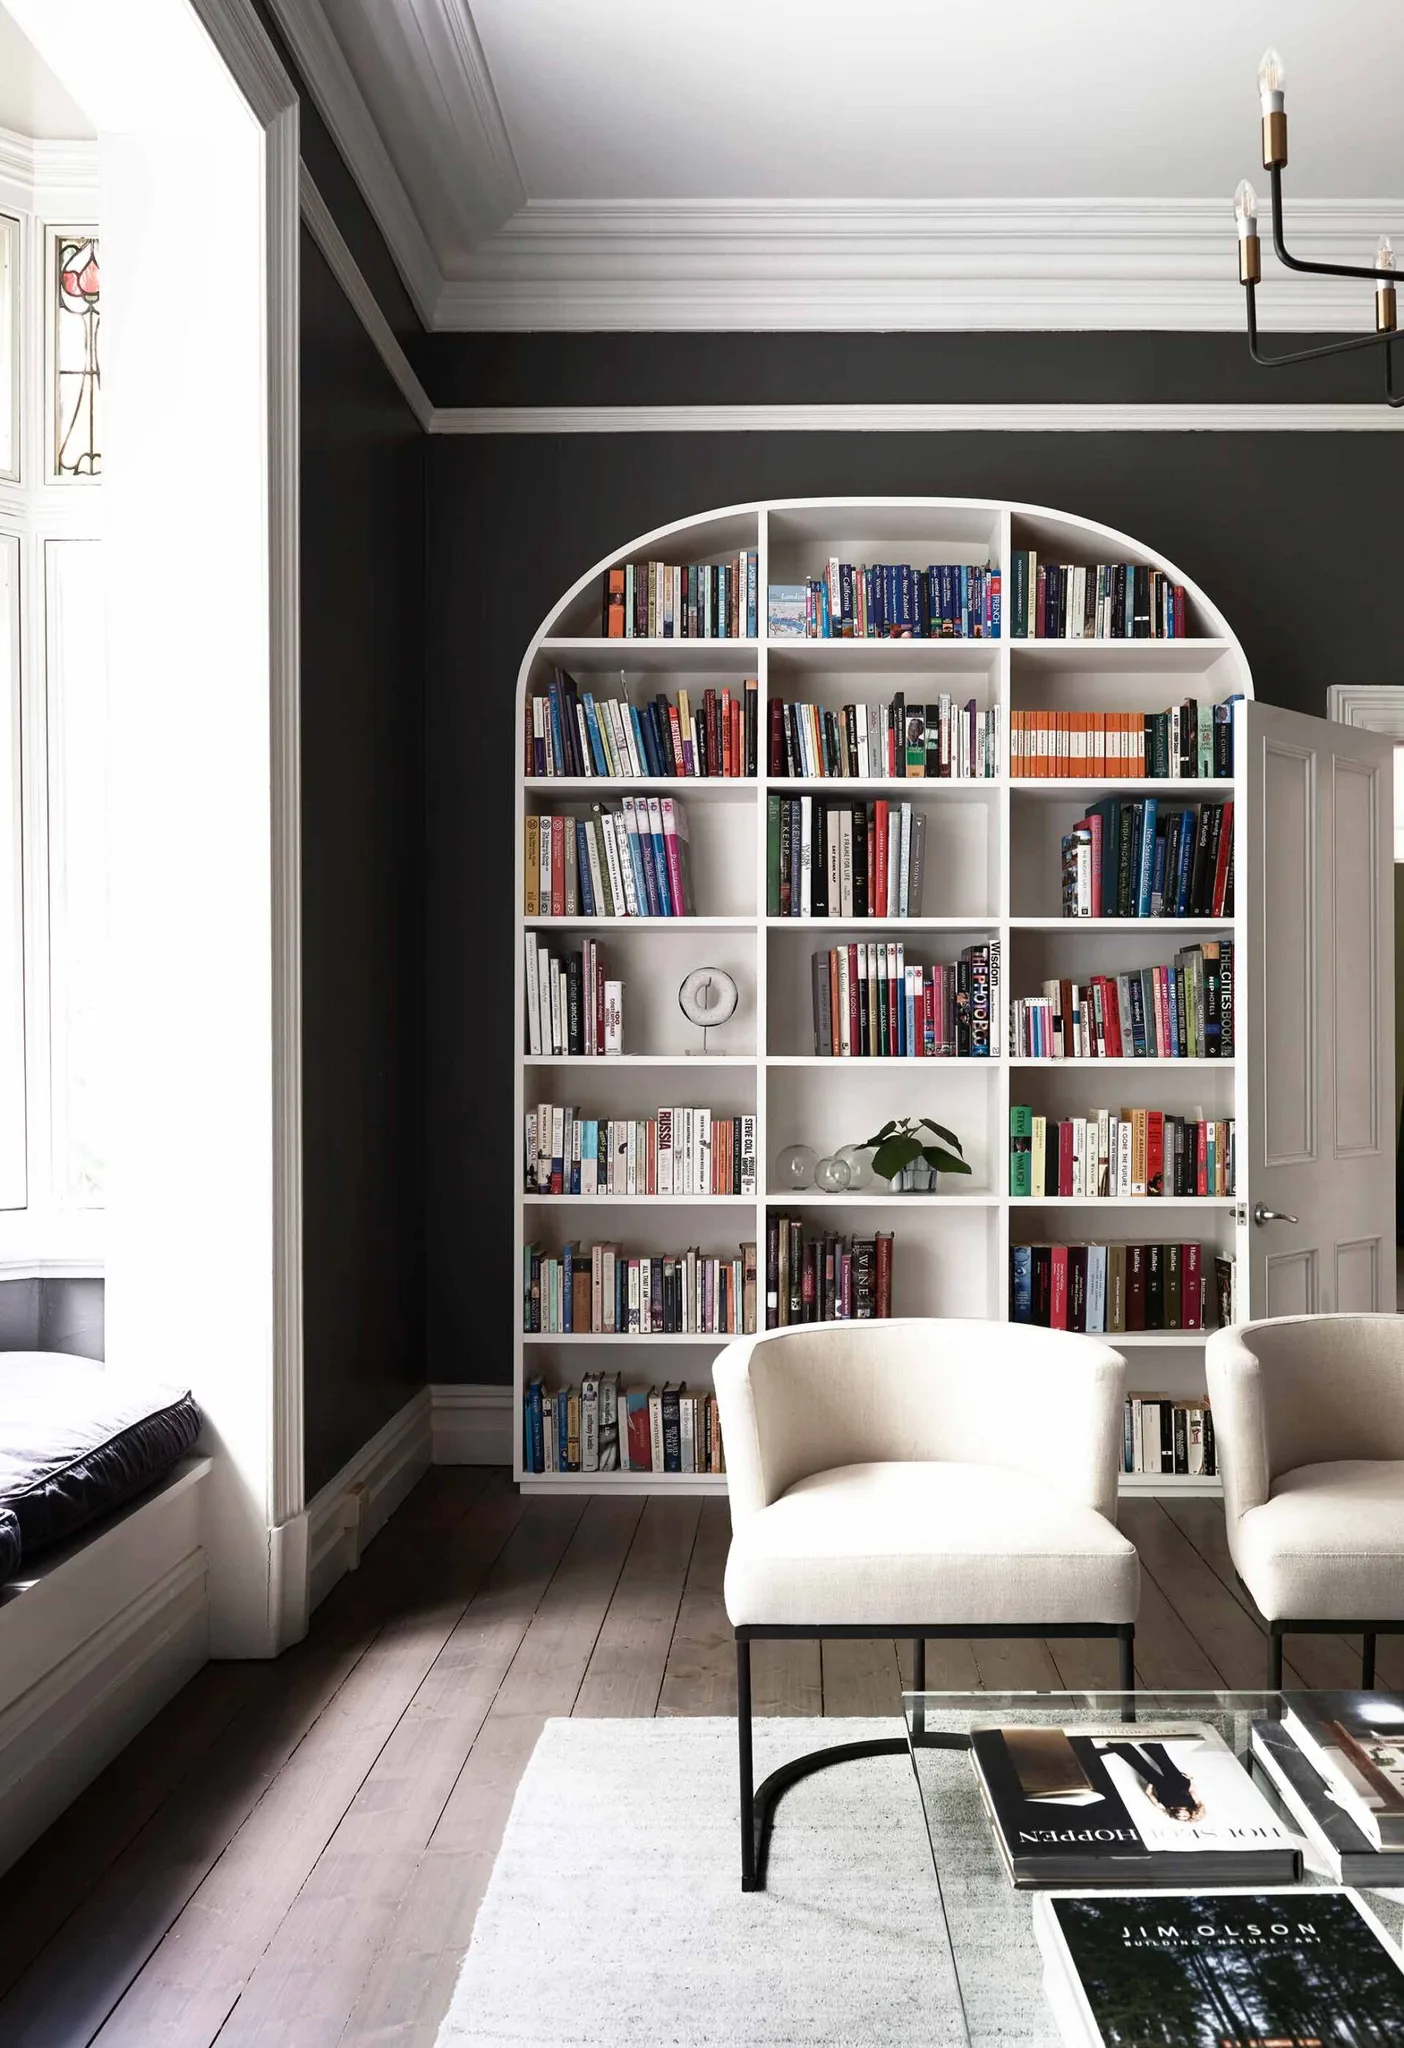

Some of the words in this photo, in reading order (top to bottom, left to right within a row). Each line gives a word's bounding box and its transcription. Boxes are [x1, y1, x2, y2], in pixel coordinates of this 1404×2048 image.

[616, 727, 626, 751] FLOW
[670, 720, 683, 763] FACTFULNESS
[1142, 871, 1151, 898] Interiors
[991, 941, 1000, 986] Wisdom
[1221, 948, 1230, 970] THE
[1221, 972, 1231, 1009] CITIES
[1221, 1011, 1231, 1044] BOOK
[659, 1112, 671, 1150] RUSSIA
[858, 1255, 869, 1296] WINE
[1019, 1828, 1139, 1843] HOPPEN
[1122, 1926, 1179, 1938] JIM
[1197, 1924, 1316, 1936] OLSON
